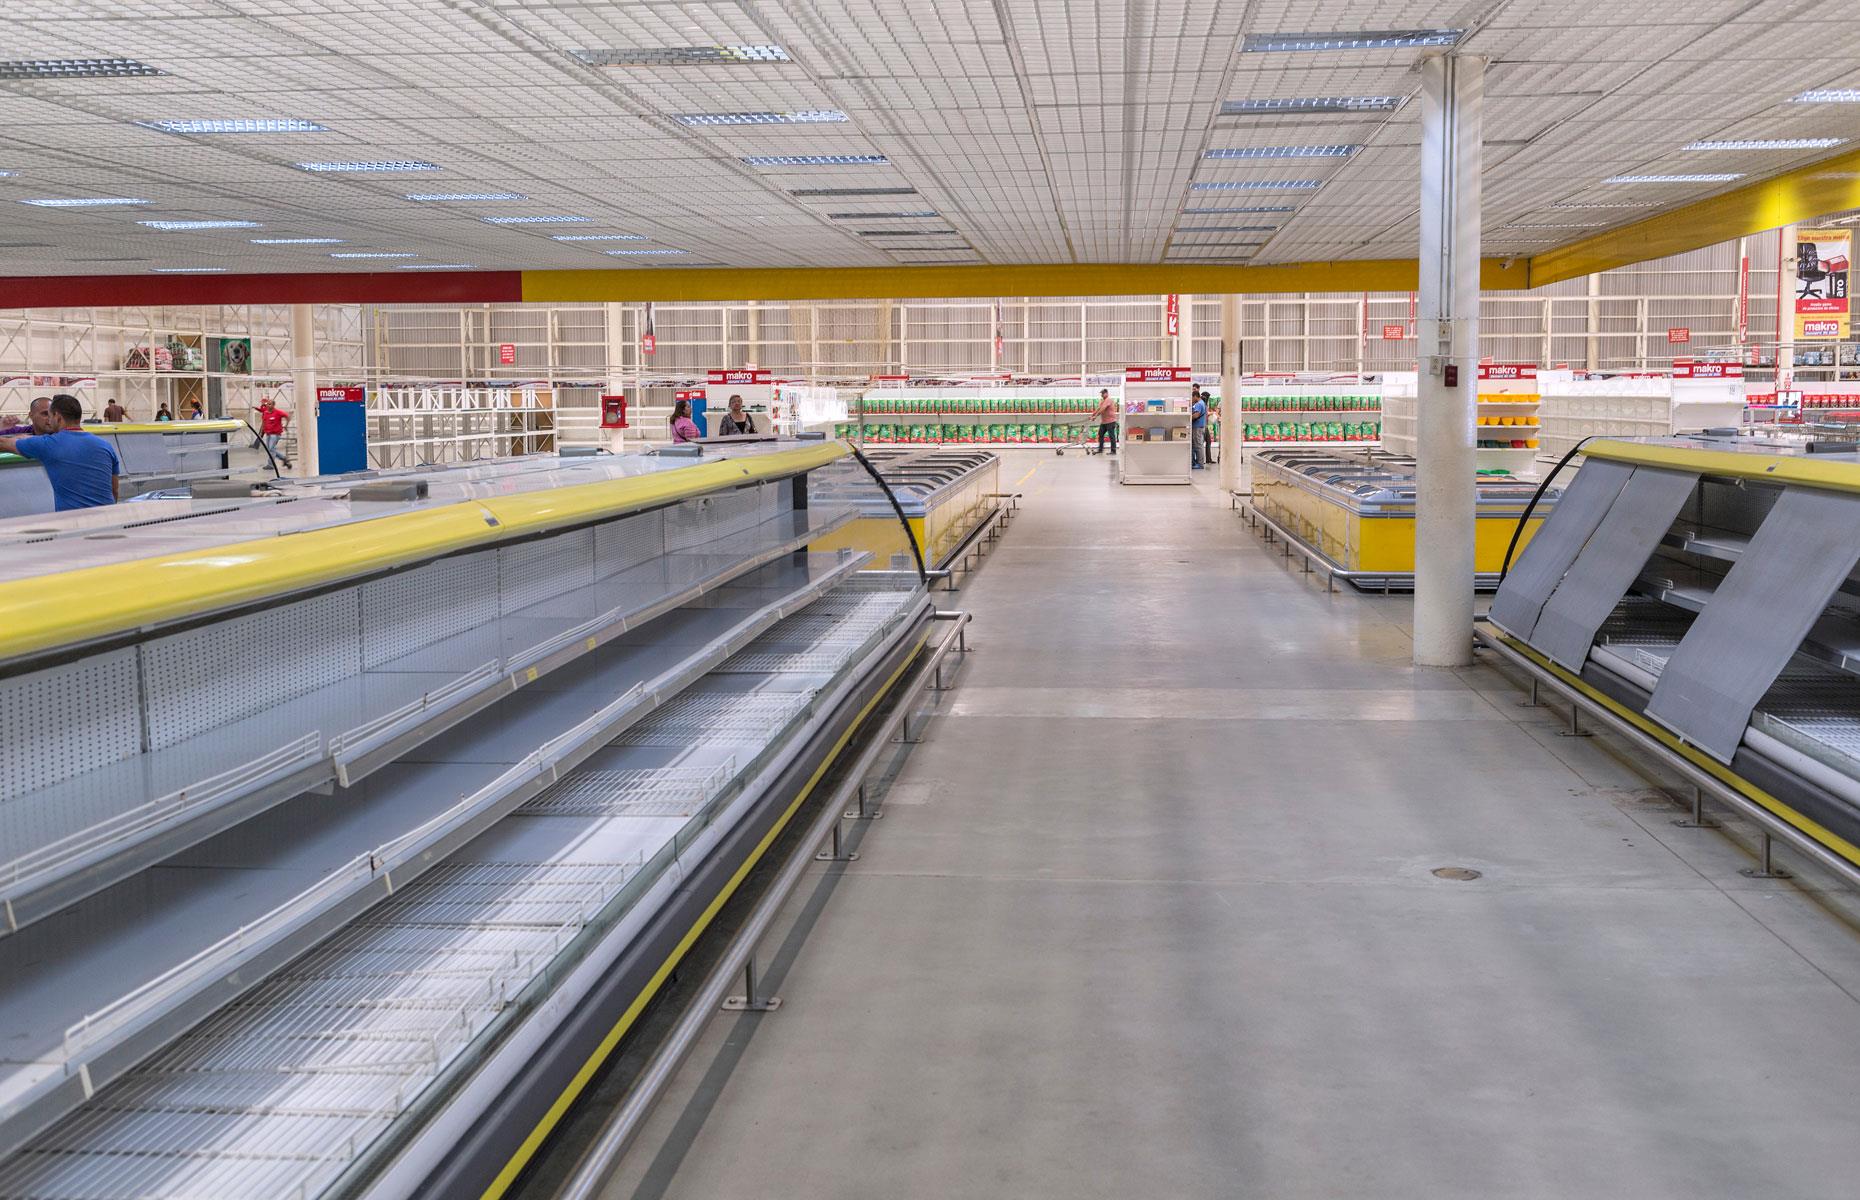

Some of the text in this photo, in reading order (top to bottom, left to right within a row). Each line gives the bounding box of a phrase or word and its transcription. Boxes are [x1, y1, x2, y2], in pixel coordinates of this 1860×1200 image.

[1805, 321, 1837, 330] makro
[1145, 368, 1172, 377] makro
[1489, 366, 1517, 374] makro
[1693, 364, 1722, 373] makro
[726, 371, 752, 379] makro
[320, 389, 345, 397] makro
